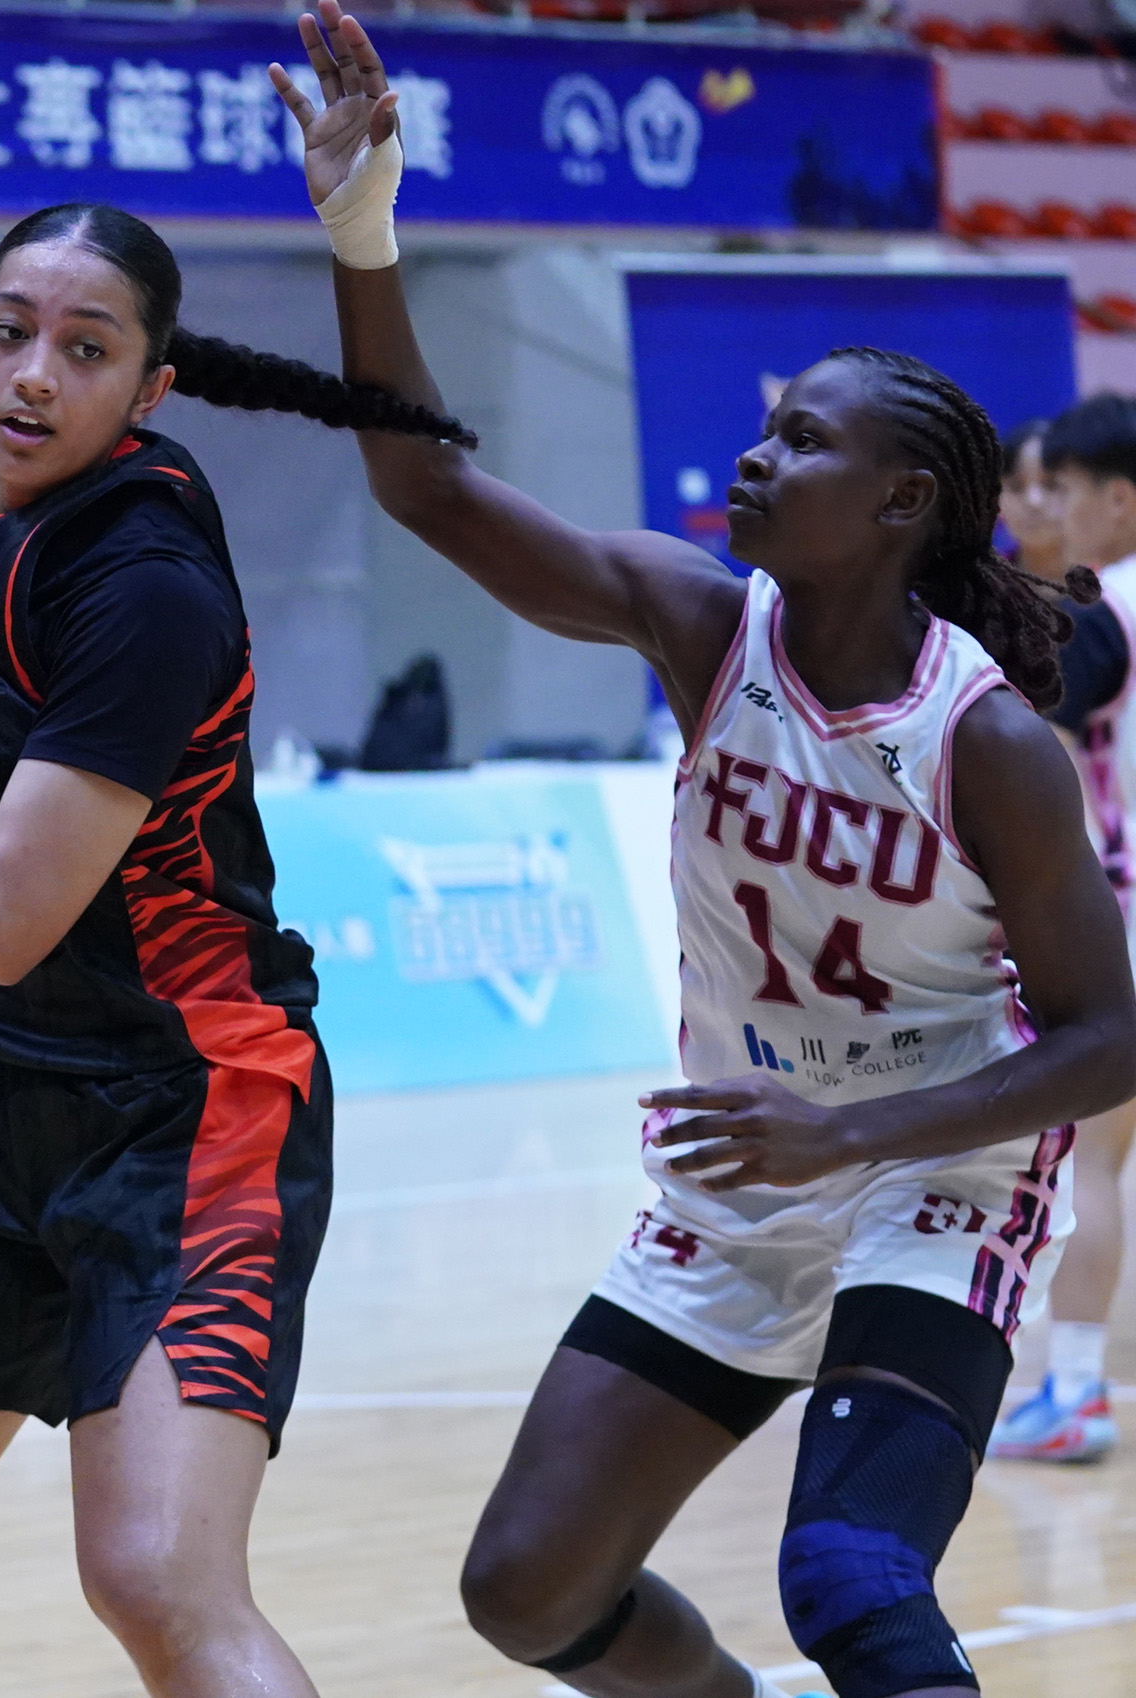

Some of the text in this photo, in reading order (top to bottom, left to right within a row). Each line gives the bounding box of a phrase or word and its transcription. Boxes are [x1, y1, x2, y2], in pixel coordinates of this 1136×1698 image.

[702, 747, 942, 908] FJCU
[732, 878, 894, 1016] 14
[851, 1051, 928, 1077] COLLEGE
